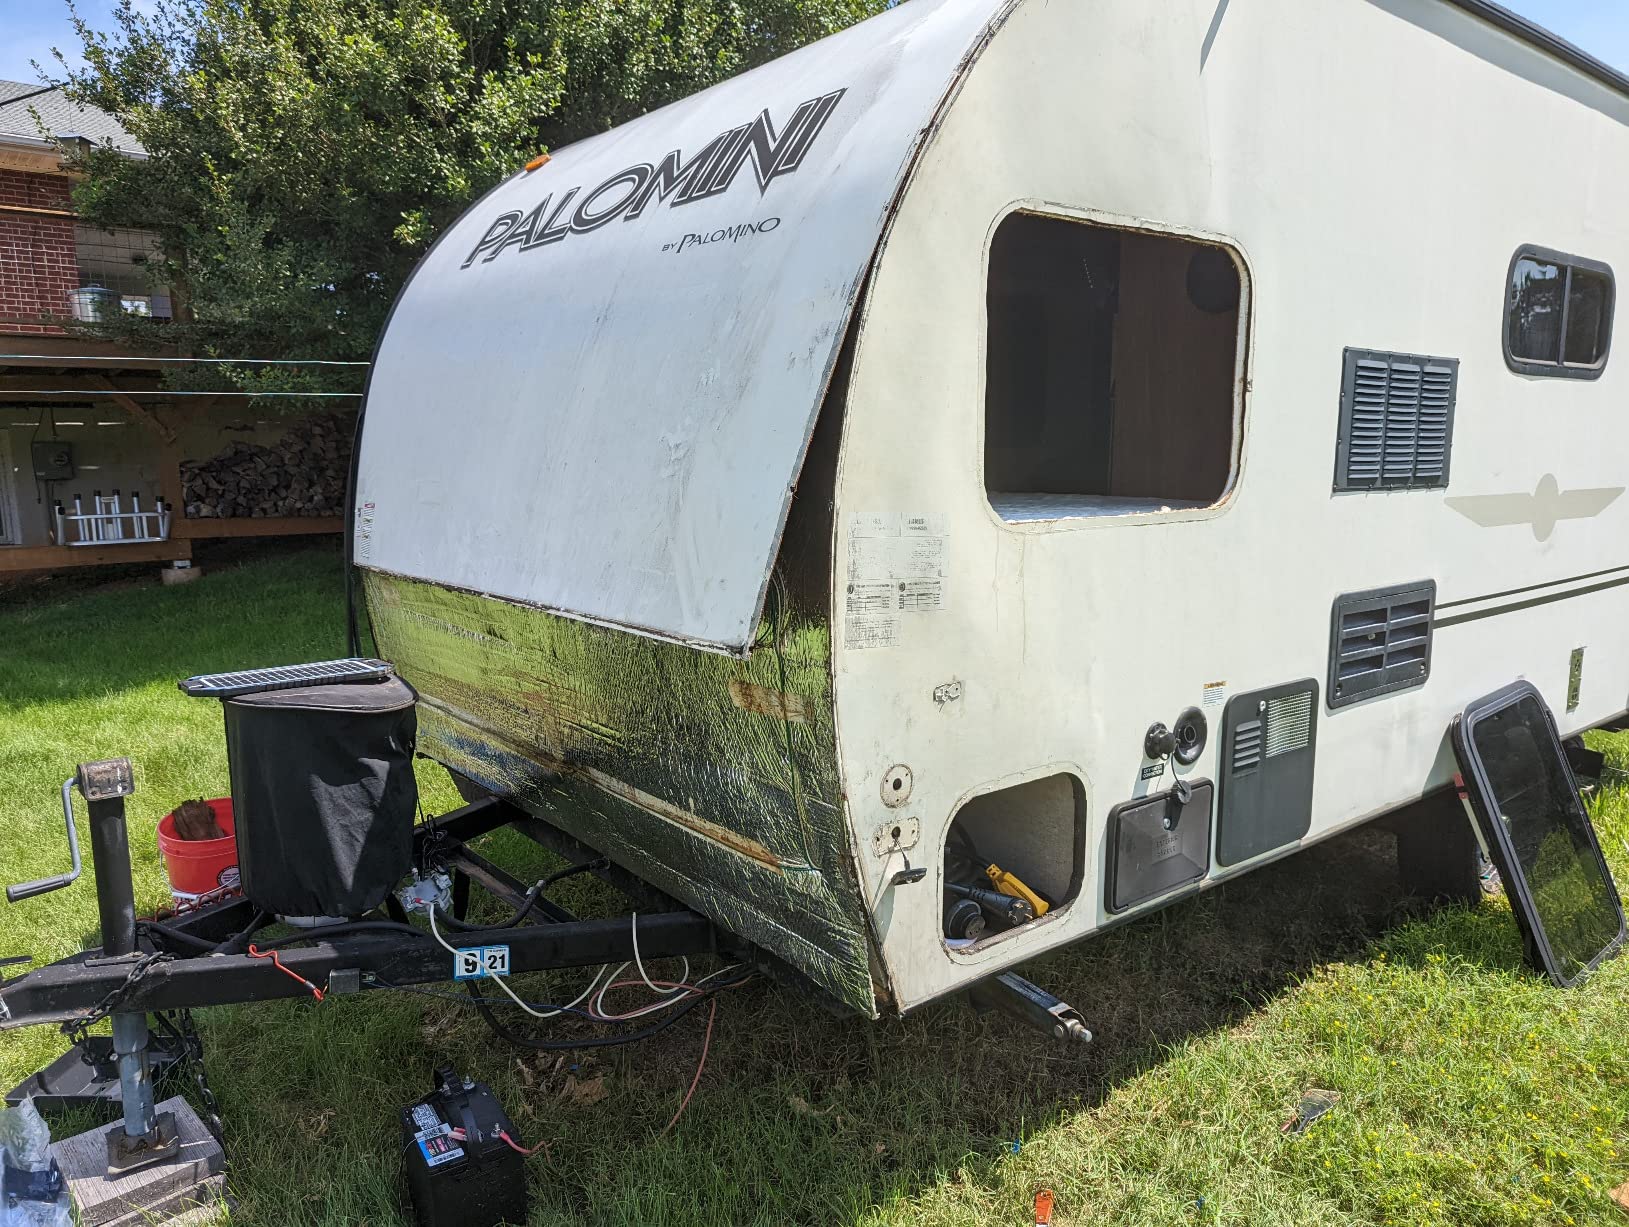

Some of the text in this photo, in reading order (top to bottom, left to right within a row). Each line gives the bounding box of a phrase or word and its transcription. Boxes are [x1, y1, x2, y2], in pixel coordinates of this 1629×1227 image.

[460, 87, 848, 270] PALOMINI
[661, 217, 781, 253] BY PALOMINO
[464, 952, 477, 974] 9
[487, 953, 505, 969] 21
